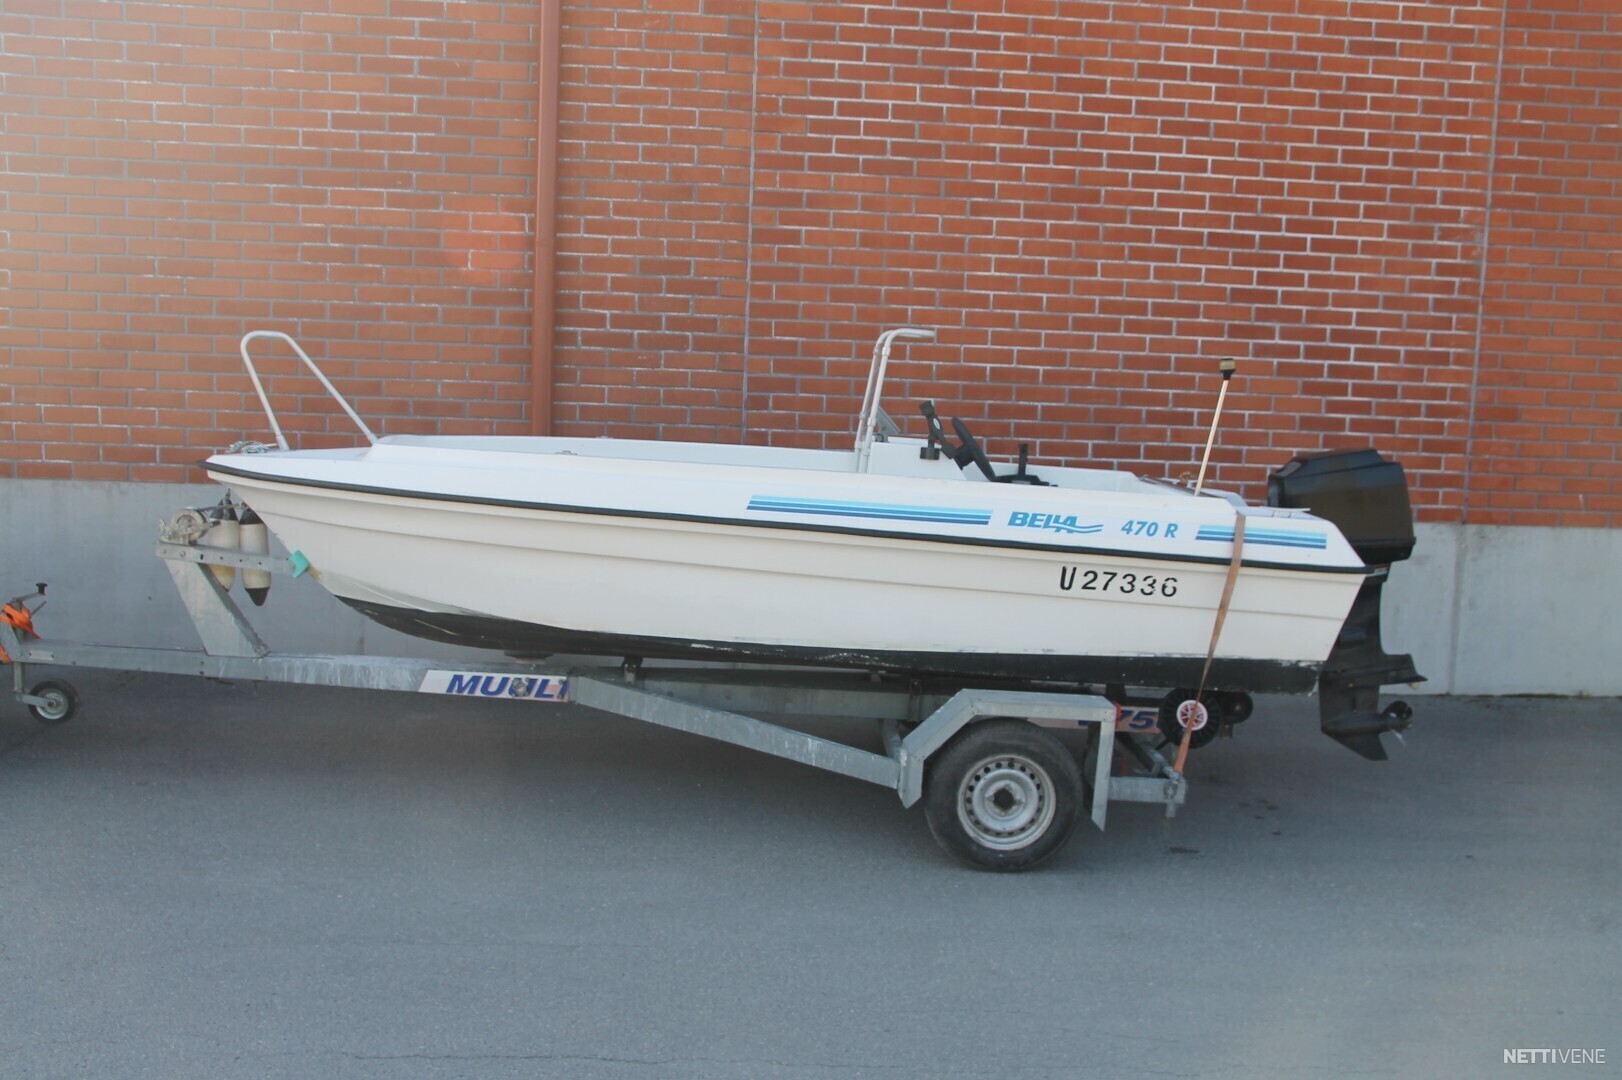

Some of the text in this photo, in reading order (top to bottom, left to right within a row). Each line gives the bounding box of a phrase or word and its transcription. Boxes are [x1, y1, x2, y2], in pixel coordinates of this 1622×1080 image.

[1008, 511, 1179, 538] BELLA 470 R
